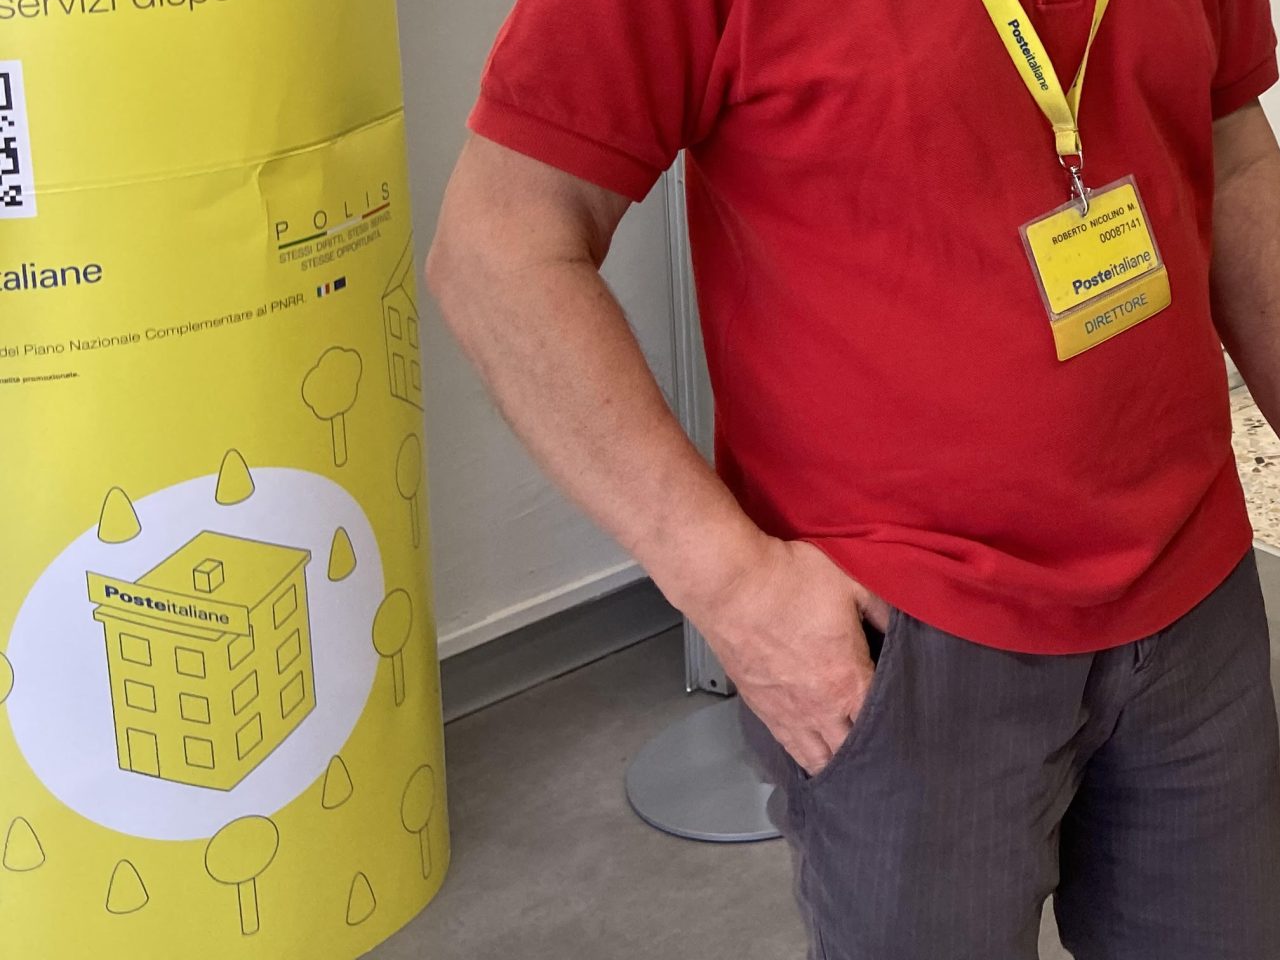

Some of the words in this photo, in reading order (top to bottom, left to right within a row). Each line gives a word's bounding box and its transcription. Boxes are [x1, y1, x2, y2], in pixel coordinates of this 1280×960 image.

[1007, 19, 1049, 91] Posteitaliane
[1052, 224, 1088, 245] ROBERTO
[1090, 206, 1125, 228] NICOLINO
[1099, 217, 1142, 244] 00087141
[0, 262, 103, 291] aliane
[1072, 250, 1151, 296] Posteitaliane
[24, 343, 65, 356] Piano
[69, 332, 141, 352] Nazionale
[145, 309, 253, 341] Complementare
[257, 304, 267, 318] al
[1084, 292, 1150, 335] DIRETTORE
[104, 584, 230, 626] Posteitaliane
